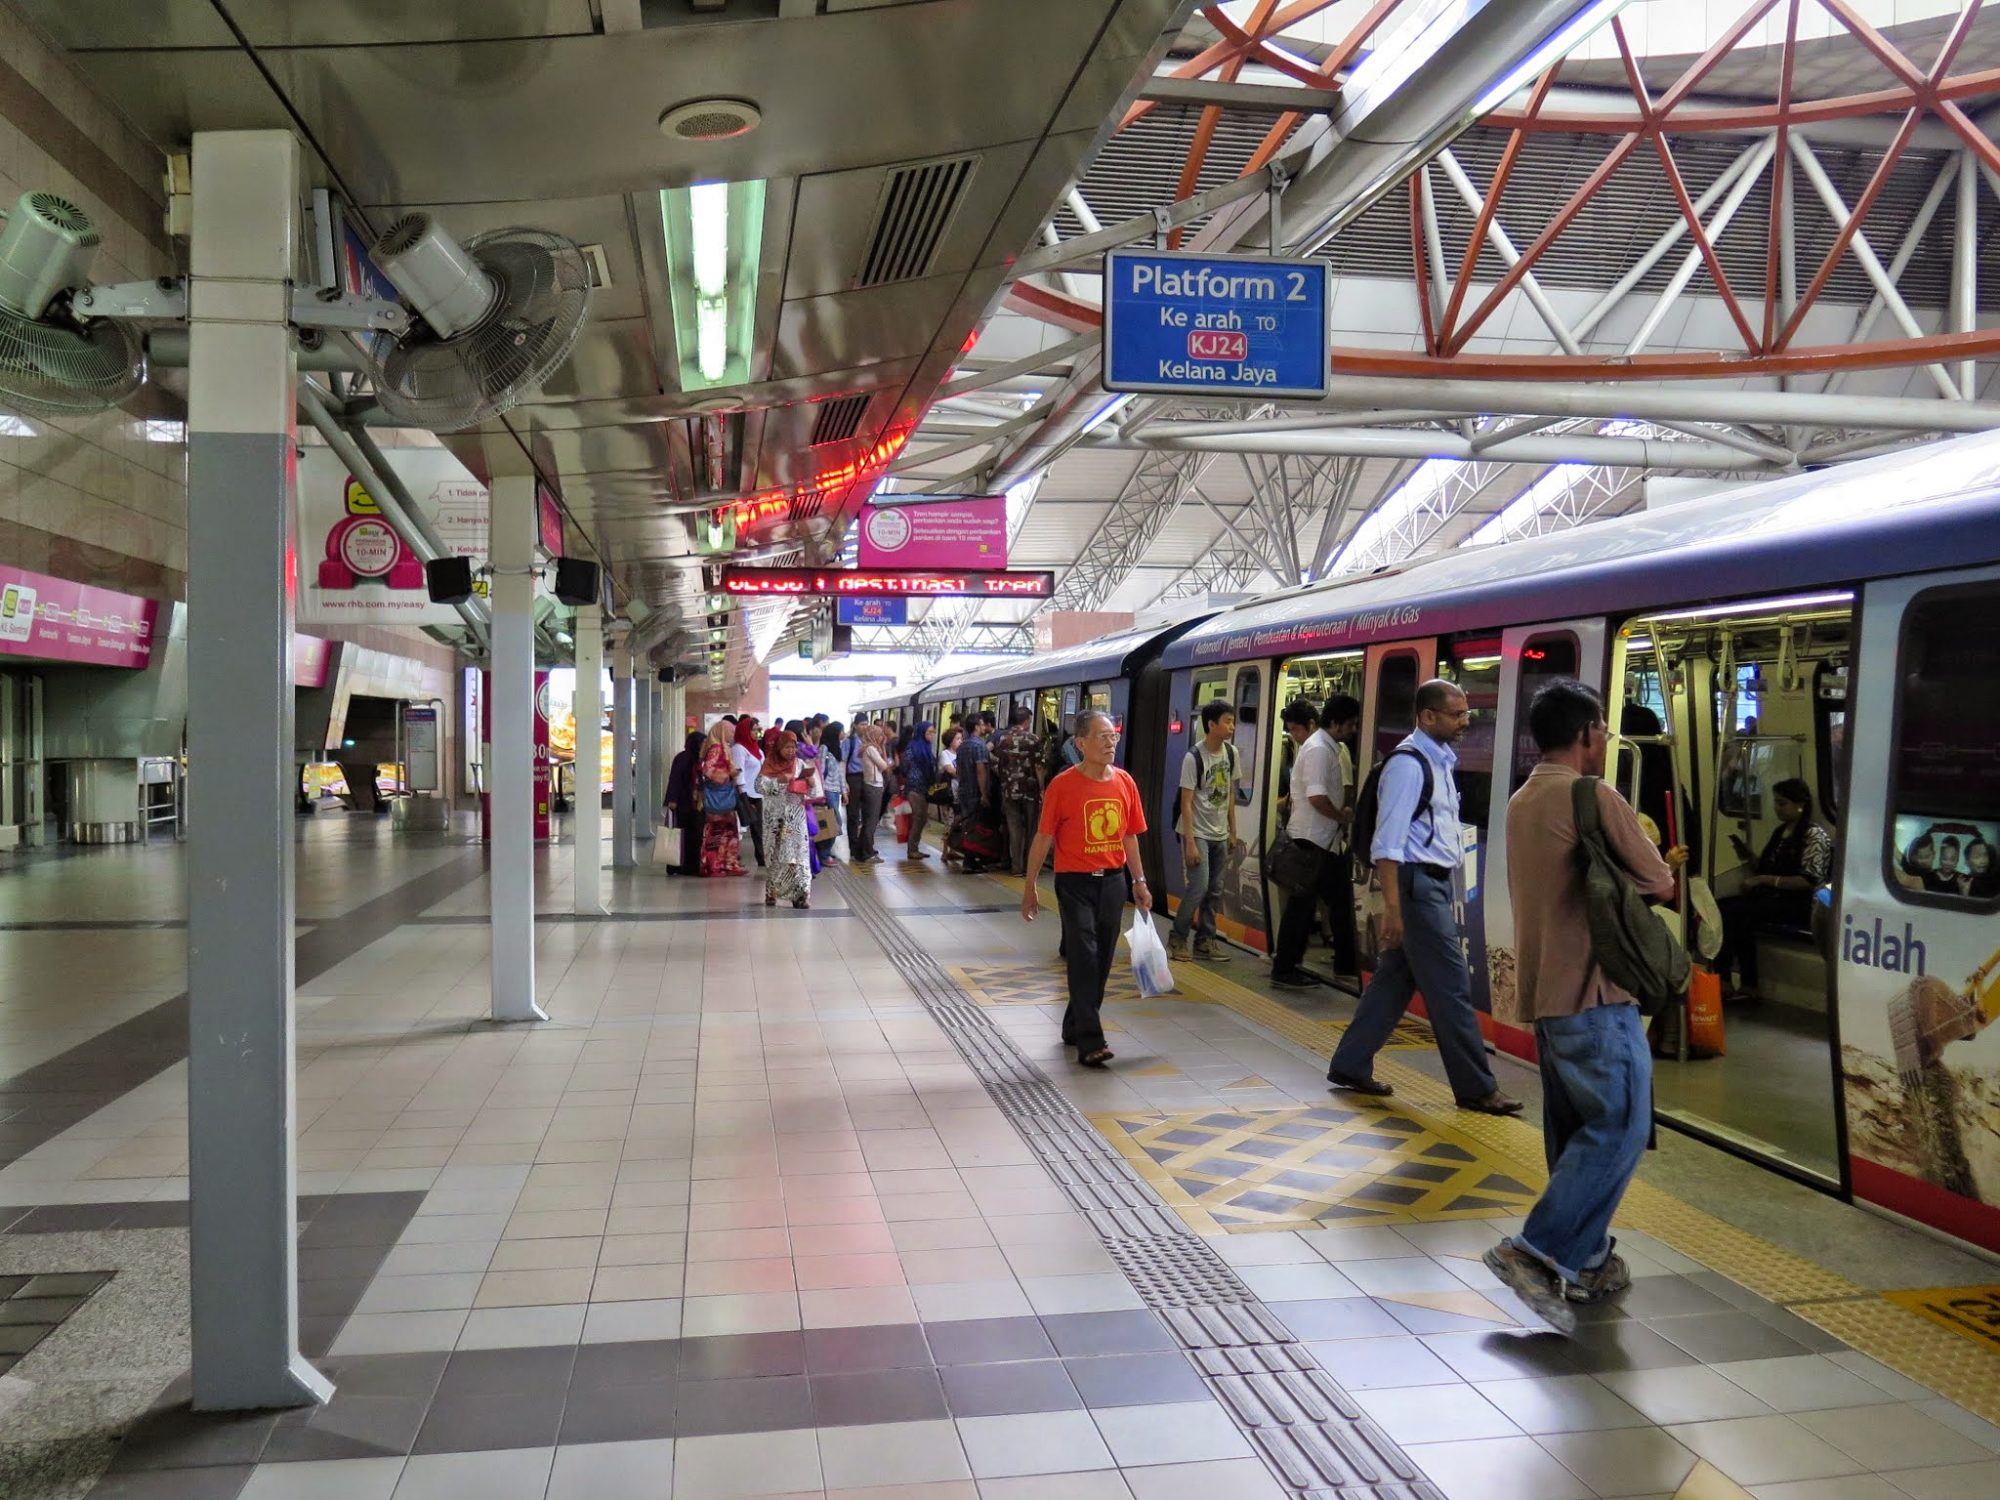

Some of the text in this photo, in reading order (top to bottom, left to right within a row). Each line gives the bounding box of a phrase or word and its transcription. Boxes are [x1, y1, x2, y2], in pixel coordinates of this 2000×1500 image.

[1132, 264, 1307, 301] Platform 2
[1160, 306, 1276, 331] Ke arah TO
[1190, 335, 1245, 355] KJ24
[1159, 360, 1278, 386] Kelana Jaya
[456, 488, 478, 498] Tidak
[356, 548, 387, 557] 10-MIN
[321, 600, 426, 610] www.rhb.com.my/easy
[1355, 608, 1392, 635] Minyak
[1391, 607, 1400, 627] &
[1401, 604, 1421, 625] Gas
[1842, 913, 1926, 978] ialah
